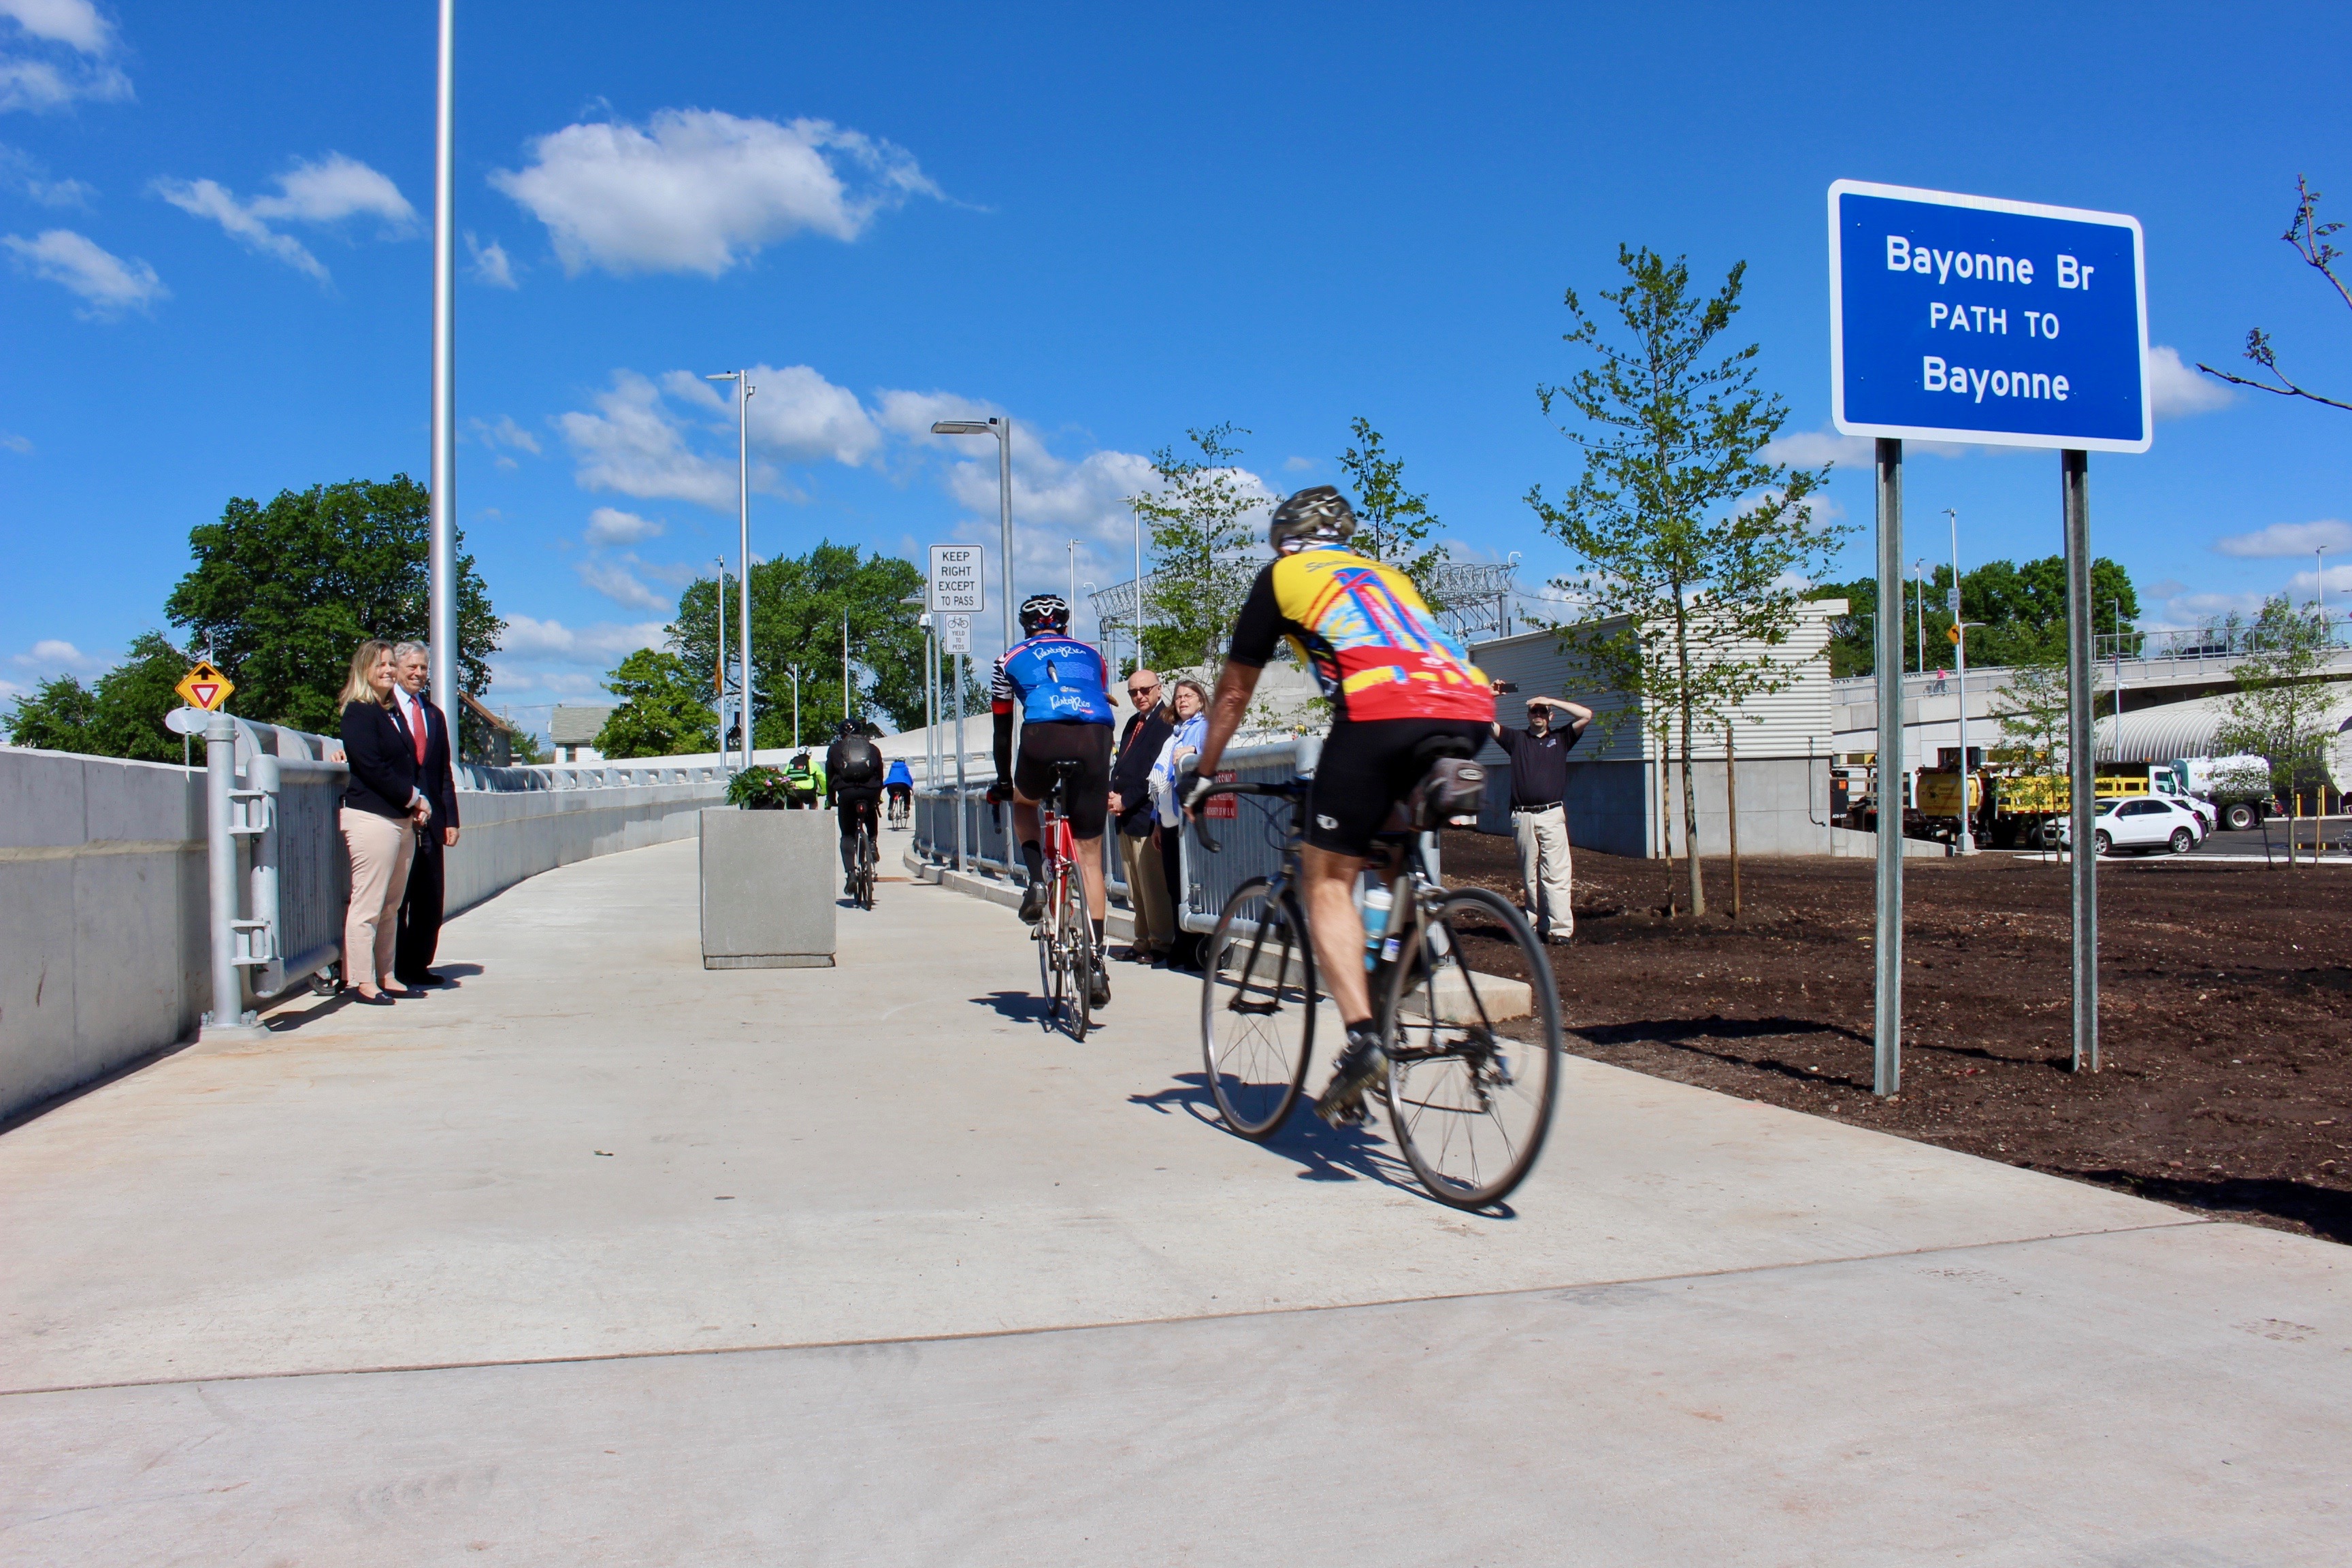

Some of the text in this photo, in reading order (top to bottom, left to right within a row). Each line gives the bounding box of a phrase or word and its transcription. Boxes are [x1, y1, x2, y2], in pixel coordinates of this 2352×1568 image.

[1886, 235, 2094, 291] Bayonne Br
[1929, 302, 2059, 340] PATH TO
[1923, 356, 2070, 404] Bayonne
[943, 551, 970, 561] KEEP
[941, 566, 971, 576] RIGHT
[938, 581, 975, 591] EXCEPT
[941, 595, 974, 606] TO PASS
